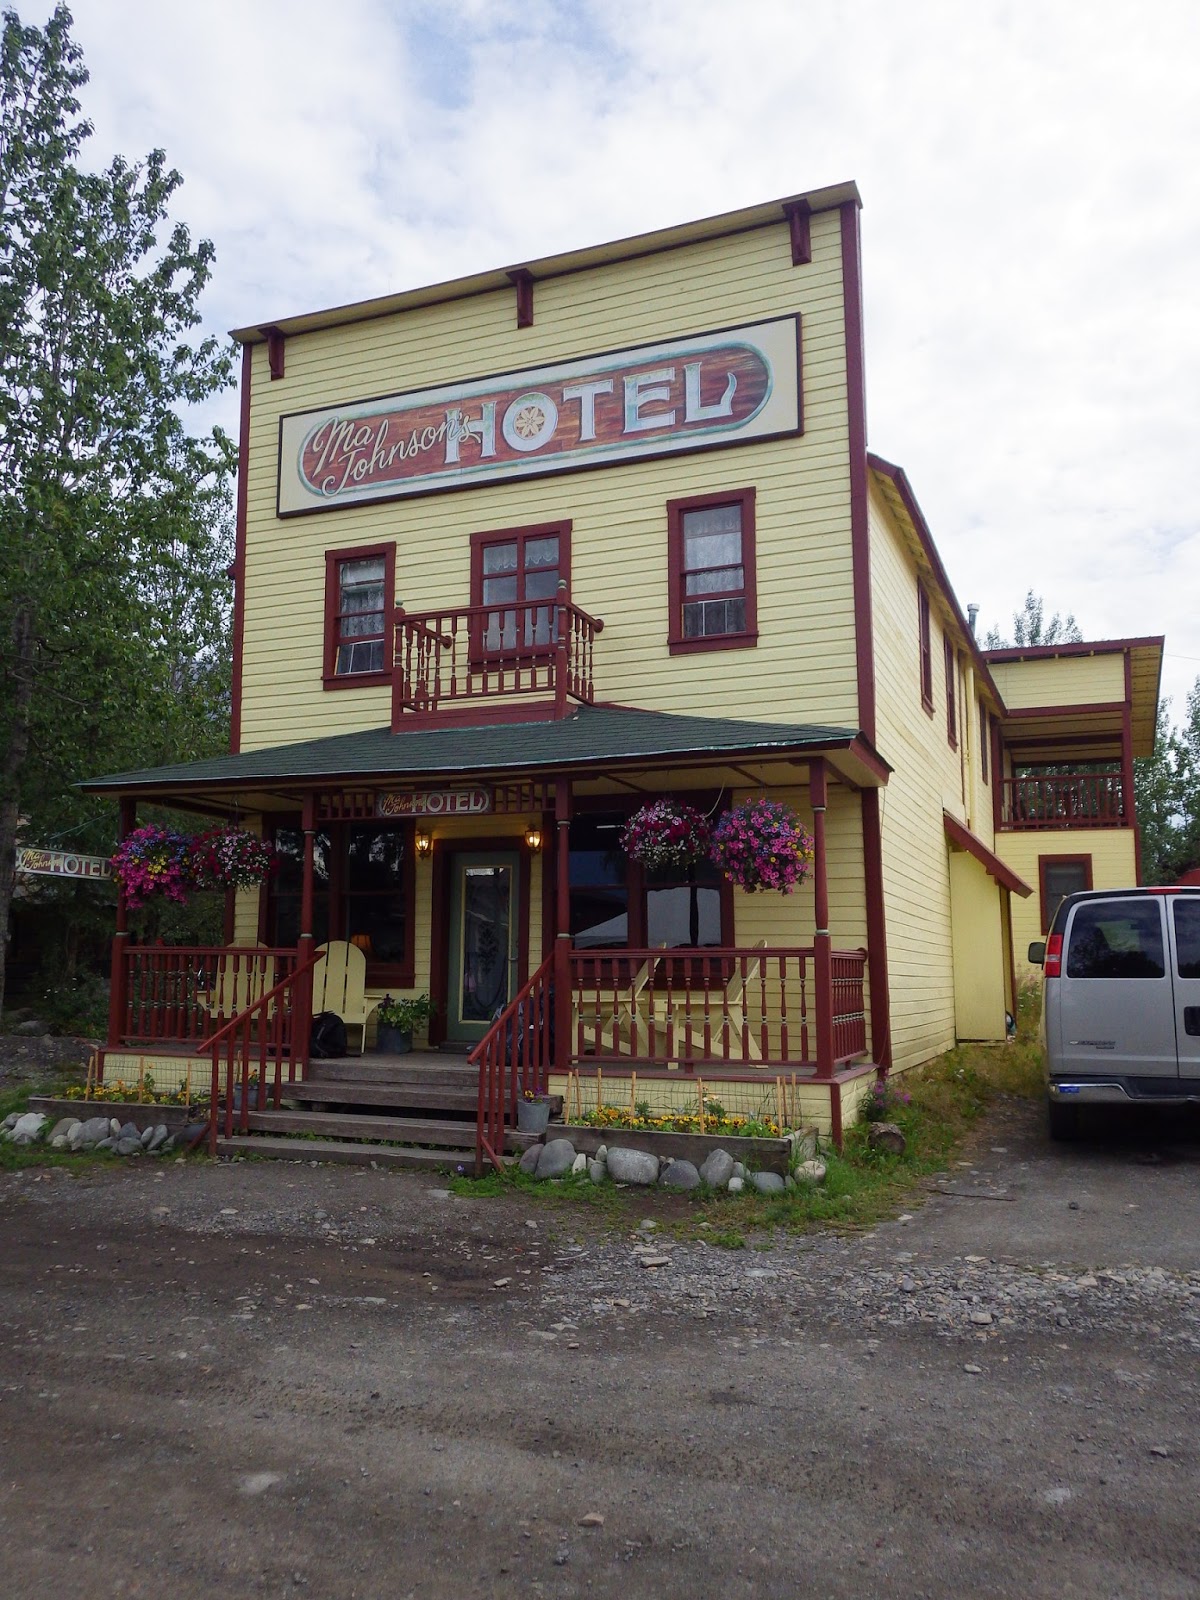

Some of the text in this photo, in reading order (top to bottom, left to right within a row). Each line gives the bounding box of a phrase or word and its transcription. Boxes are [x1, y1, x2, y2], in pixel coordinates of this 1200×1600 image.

[443, 362, 737, 464] HOTEL
[312, 416, 374, 477] Ma
[321, 412, 482, 498] Johnson's
[385, 797, 427, 815] Johns
[411, 792, 483, 812] HOTEL
[26, 854, 62, 870] Johns
[50, 854, 112, 877] HOTEL
